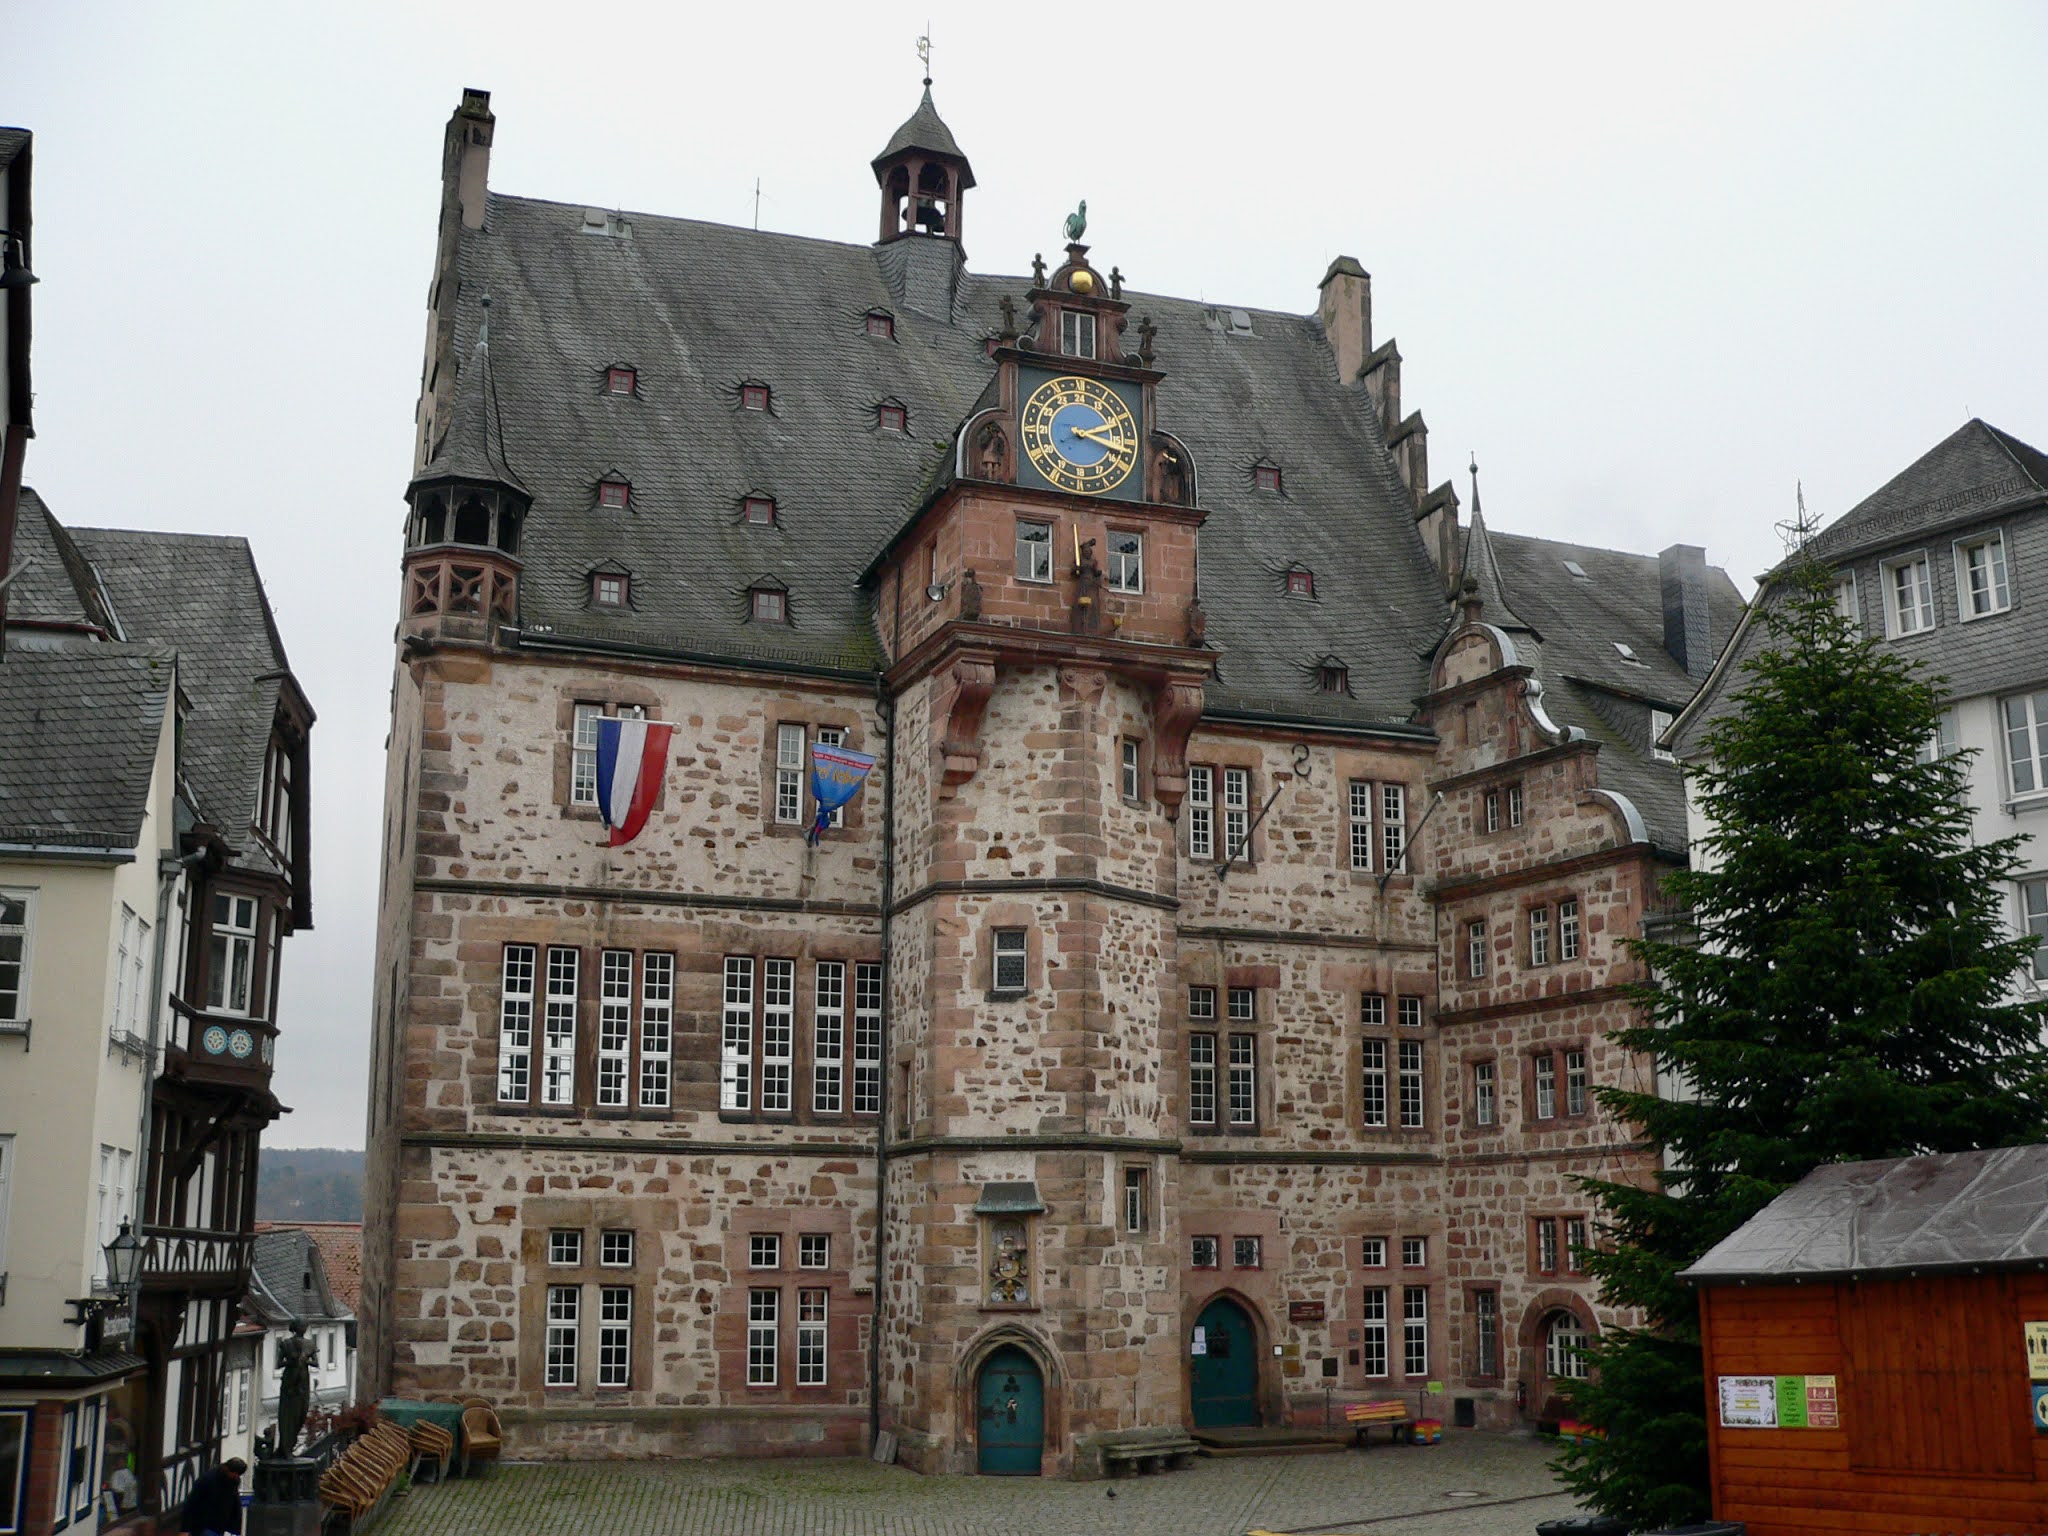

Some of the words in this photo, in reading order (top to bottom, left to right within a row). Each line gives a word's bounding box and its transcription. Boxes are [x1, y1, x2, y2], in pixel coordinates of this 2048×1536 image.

[1057, 396, 1068, 405] 23
[1074, 394, 1086, 403] 24
[1094, 401, 1102, 410] 13
[1044, 408, 1054, 416] 22
[1040, 426, 1048, 434] 21
[1044, 444, 1054, 454] 20
[1108, 453, 1116, 462] 16
[1058, 460, 1066, 469] 19
[1076, 468, 1085, 477] 18
[1096, 466, 1104, 474] 17
